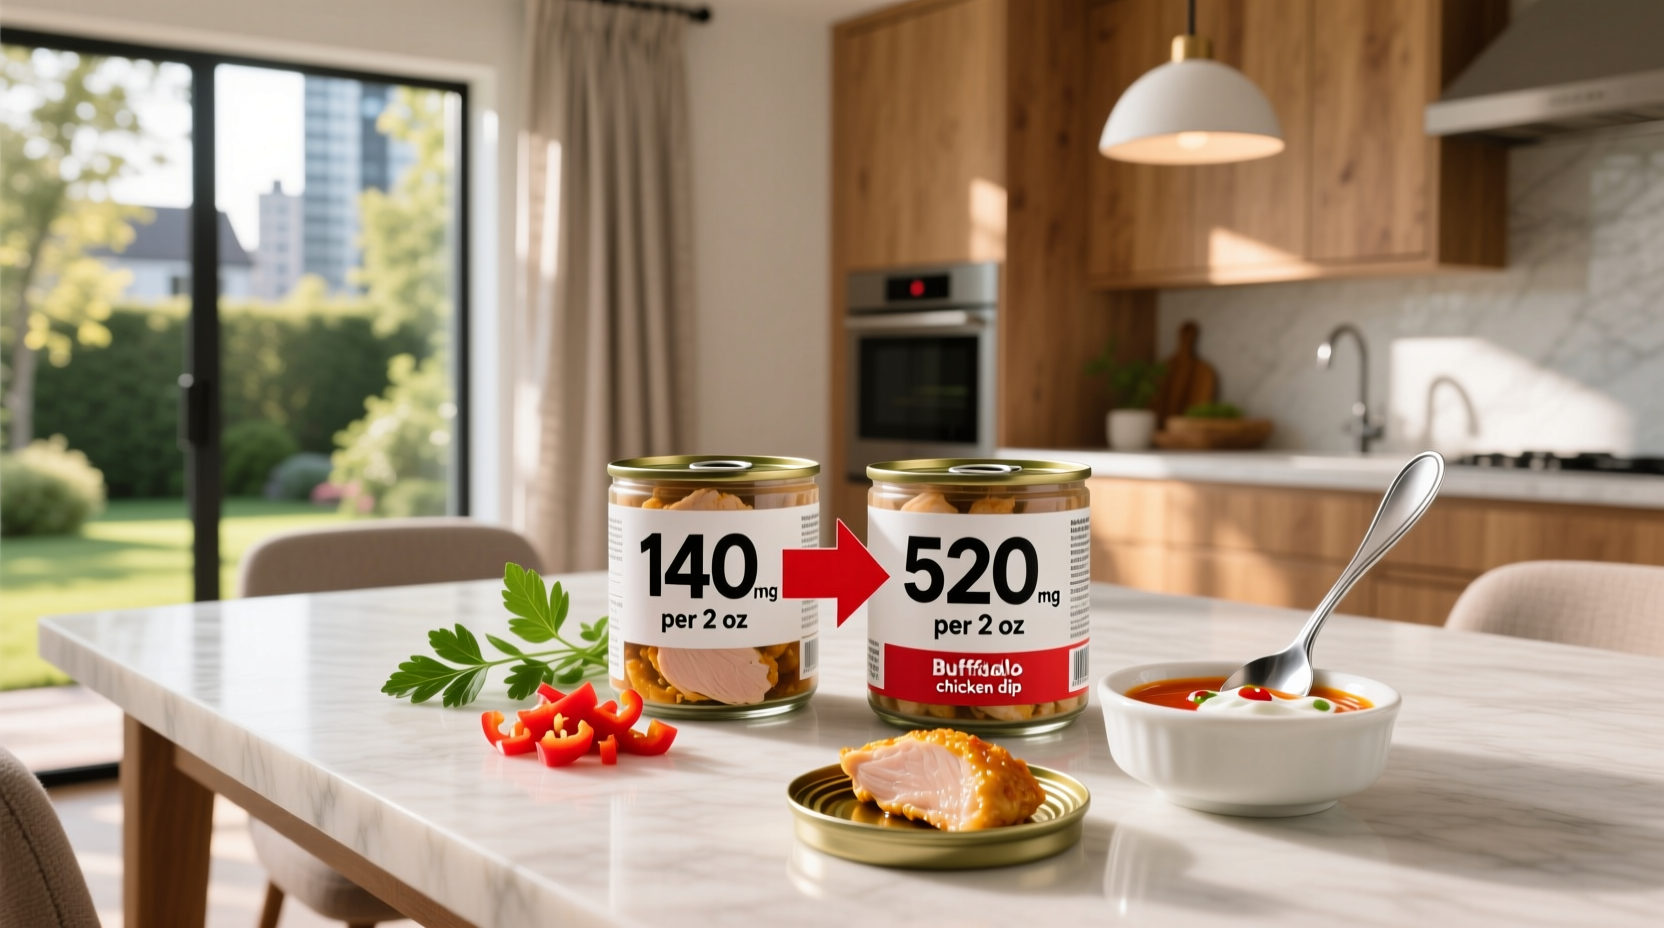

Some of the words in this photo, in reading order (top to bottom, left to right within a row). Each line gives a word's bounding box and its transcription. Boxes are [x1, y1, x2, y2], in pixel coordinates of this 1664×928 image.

[661, 613, 698, 634] per
[702, 608, 717, 629] 2
[722, 613, 748, 629] oz
[934, 618, 973, 640] per
[978, 613, 993, 636] 2
[998, 619, 1025, 636] oz
[936, 679, 994, 694] chicken
[997, 678, 1022, 697] dip
